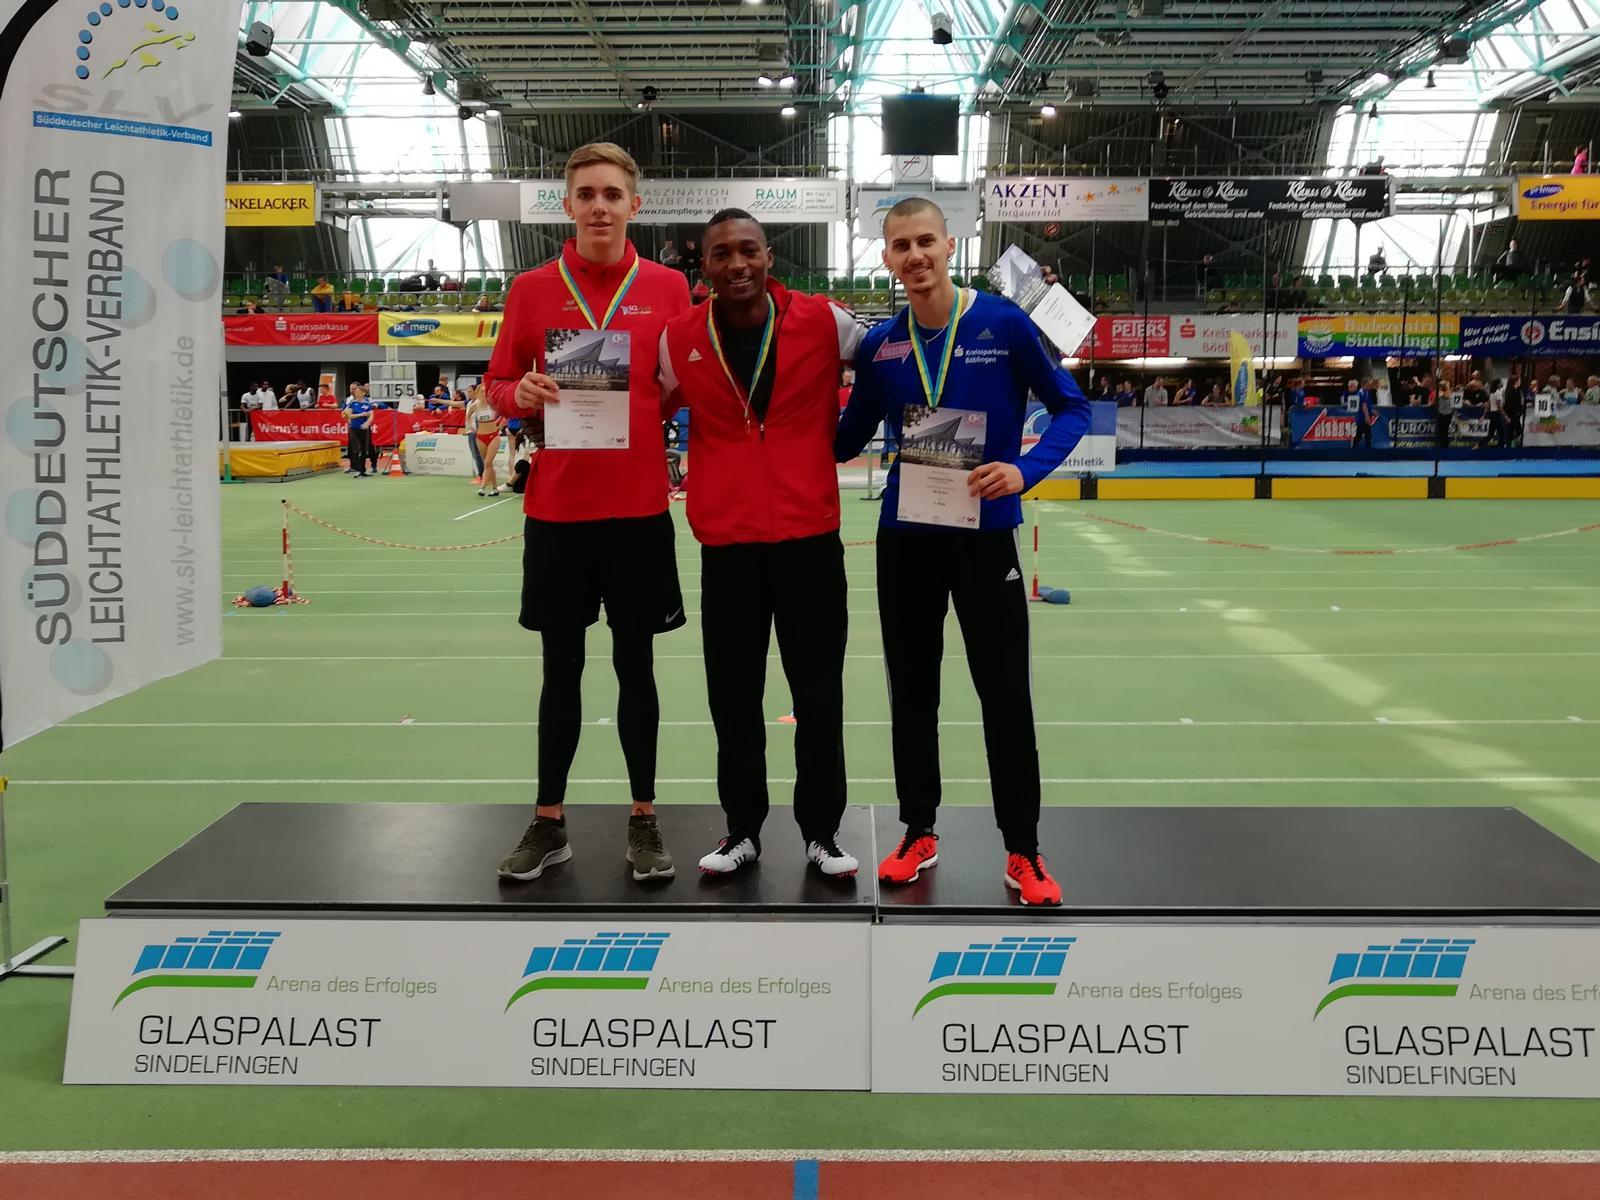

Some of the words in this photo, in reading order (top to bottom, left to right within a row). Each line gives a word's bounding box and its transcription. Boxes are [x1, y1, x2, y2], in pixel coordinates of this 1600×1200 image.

[36, 114, 103, 130] Süddeutscher
[104, 121, 208, 143] Leichtathletik-Verband
[645, 197, 727, 205] AUBERKEIT
[755, 188, 797, 200] RAUM
[992, 184, 1069, 198] AKZENT
[1168, 181, 1201, 202] Klauss
[1215, 181, 1249, 202] Klauss
[1286, 181, 1320, 202] Klauss
[1333, 181, 1368, 202] Klauss
[638, 207, 725, 217] www.raumpflege-ag.
[289, 323, 349, 332] Kreissparkasse
[1112, 323, 1166, 337] PETERS
[384, 384, 415, 396] 155
[28, 168, 72, 645] SÜDDEUTSCHER
[86, 170, 125, 643] LEICHTATHLETIK-VERBAND
[259, 422, 299, 434] Wenn's
[301, 425, 319, 434] um
[321, 421, 348, 435] Geld
[169, 335, 196, 647] www.slv-leichtathletik.de
[266, 975, 321, 993] Arena
[327, 976, 360, 994] des
[364, 977, 437, 998] Erfolges
[658, 977, 713, 993] Arena
[720, 978, 752, 994] des
[758, 978, 832, 998] Erfolges
[1067, 982, 1123, 999] Arena
[1130, 982, 1162, 999] des
[1168, 983, 1242, 1003] Erfolges
[1469, 984, 1527, 1000] Arena
[1533, 985, 1566, 1001] des
[139, 1015, 381, 1048] GLASPALAST
[533, 1018, 777, 1049] GLASPALAST
[942, 1023, 1189, 1055] GLASPALAST
[1345, 1025, 1595, 1058] GLASPALAST
[134, 1054, 298, 1075] SINDELFINGEN
[530, 1057, 695, 1077] SINDELFINGEN
[941, 1063, 1109, 1083] SINDELFINGEN
[1346, 1065, 1516, 1086] SINDELFINGEN
